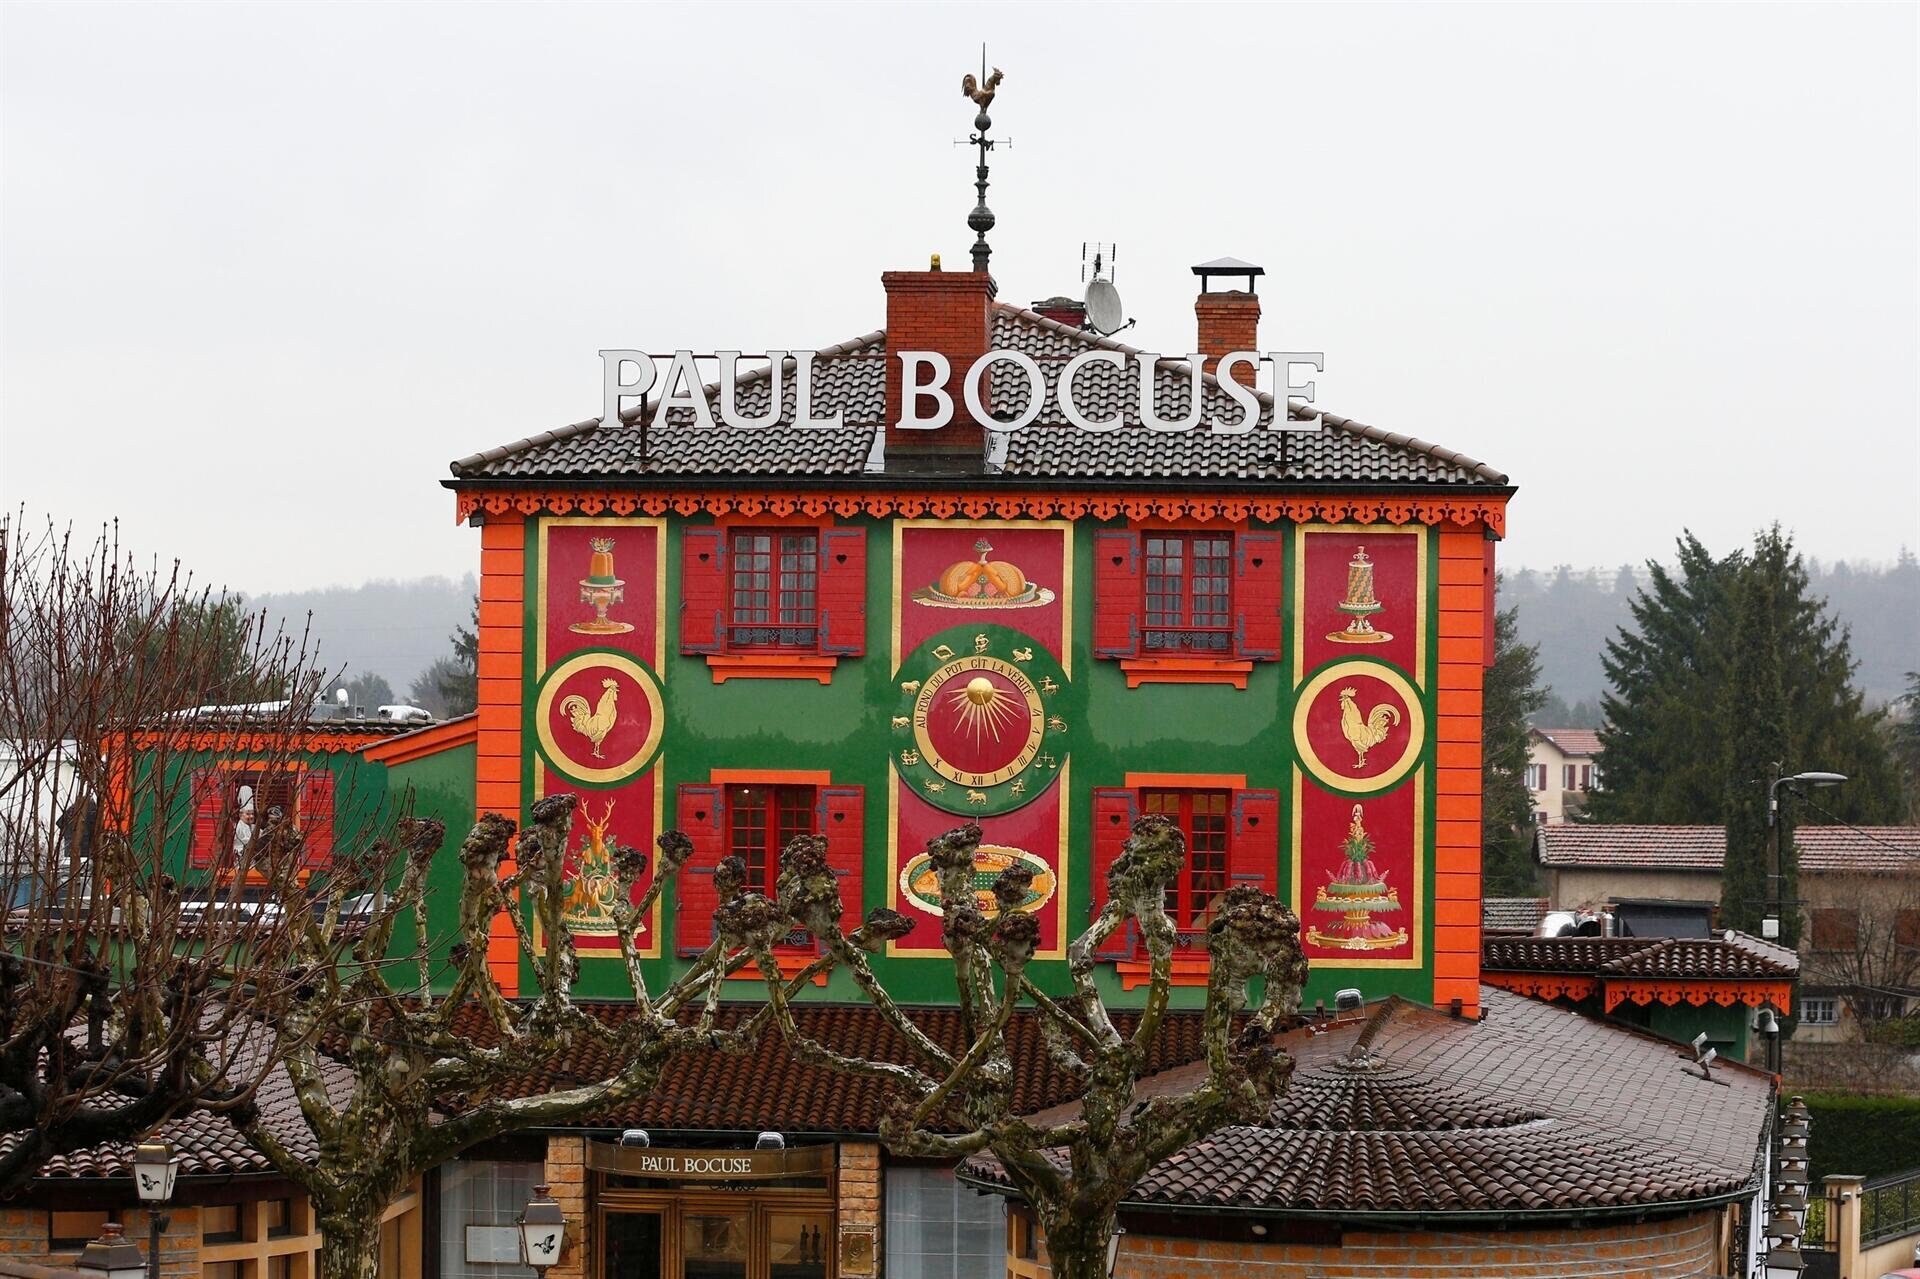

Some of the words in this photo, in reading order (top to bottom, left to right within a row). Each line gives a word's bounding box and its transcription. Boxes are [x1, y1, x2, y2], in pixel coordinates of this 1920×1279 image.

[598, 349, 844, 429] PAUL
[895, 350, 1324, 434] BOCUSE
[944, 662, 963, 677] POT
[992, 661, 1004, 673] LA
[930, 673, 944, 688] DU
[1007, 668, 1035, 698] VÉRITÉ
[918, 689, 933, 713] FOND
[916, 716, 927, 728] AU
[933, 758, 942, 768] X
[952, 772, 963, 782] XI
[971, 776, 983, 786] XII
[1007, 766, 1015, 776] II
[1017, 755, 1028, 767] III
[1032, 726, 1041, 735] V
[641, 1156, 680, 1172] PAUL
[684, 1158, 752, 1173] BOCUSE
